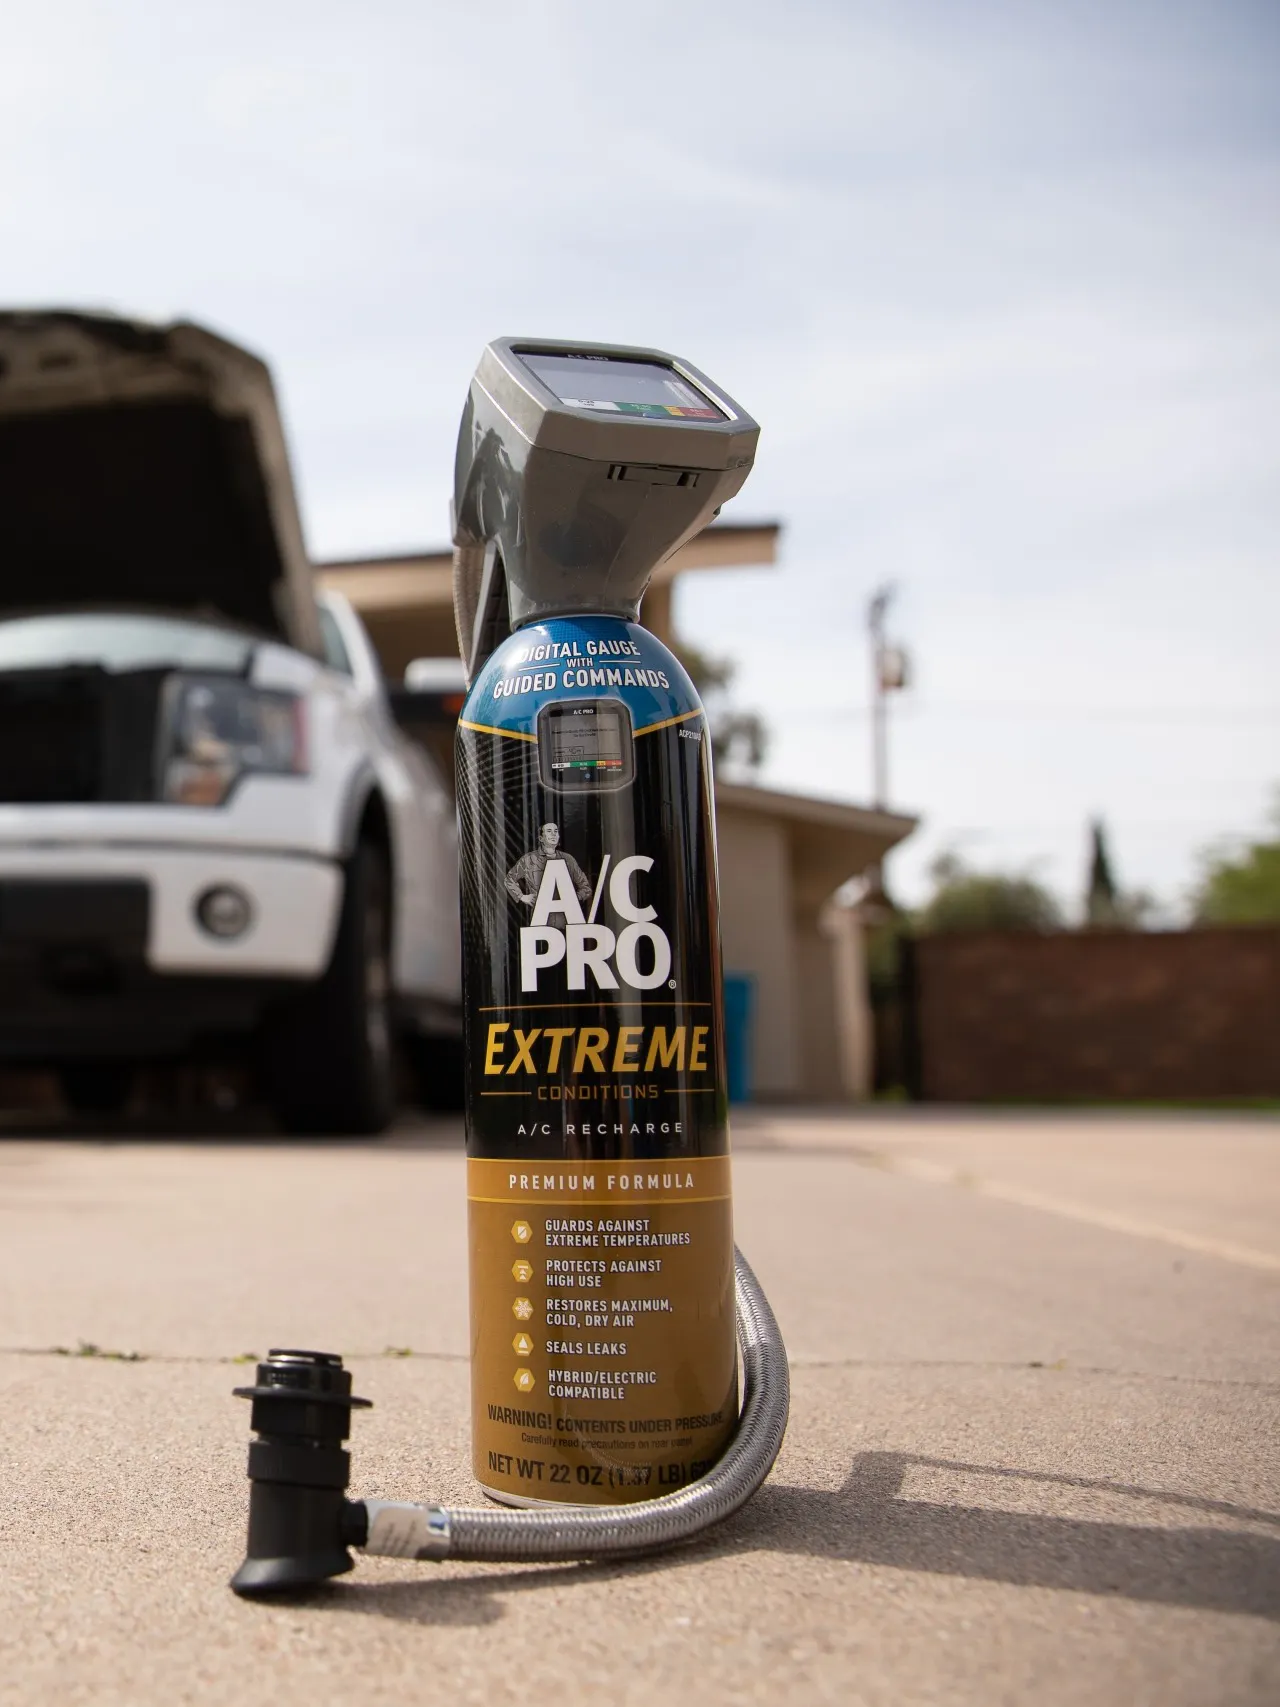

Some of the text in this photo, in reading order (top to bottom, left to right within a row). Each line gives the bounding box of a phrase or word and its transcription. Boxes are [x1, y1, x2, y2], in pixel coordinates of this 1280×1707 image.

[521, 640, 641, 662] DIGITAL GAUGE
[566, 657, 594, 668] WITH
[493, 668, 670, 699] GUIDED COMMANDS
[530, 854, 659, 927] A/C
[484, 1022, 709, 1075] EXTREME
[537, 1084, 659, 1101] CONDITIONS
[517, 1122, 684, 1136] A/C RECHARGE
[509, 1173, 694, 1190] PREMIUM FORMULA
[545, 1219, 649, 1232] GUARDS AGAINST
[545, 1232, 691, 1247] EXTREME TEMPERATURES
[546, 1259, 662, 1273] PROTECTS AGAINST
[546, 1274, 602, 1288] HIGH USE
[546, 1299, 673, 1313] RESTORES MAXIMUM,
[546, 1313, 634, 1328] COLD, DRY AIR
[546, 1341, 627, 1355] SEALS LEAKS
[548, 1369, 657, 1384] HYBRID/ELECTRIC
[548, 1385, 625, 1399] COMPATIBLE
[487, 1403, 552, 1430] WARNING!
[556, 1417, 625, 1434] CONTENTS
[629, 1418, 672, 1433] UNDER
[521, 1432, 557, 1448] Carefully
[558, 1437, 579, 1448] read
[581, 1438, 636, 1451] precautions
[638, 1440, 649, 1449] on
[488, 1451, 513, 1475] NET
[516, 1457, 545, 1481] WT
[550, 1464, 570, 1483] 22
[576, 1465, 603, 1486] OZ
[658, 1462, 686, 1486] LB)
